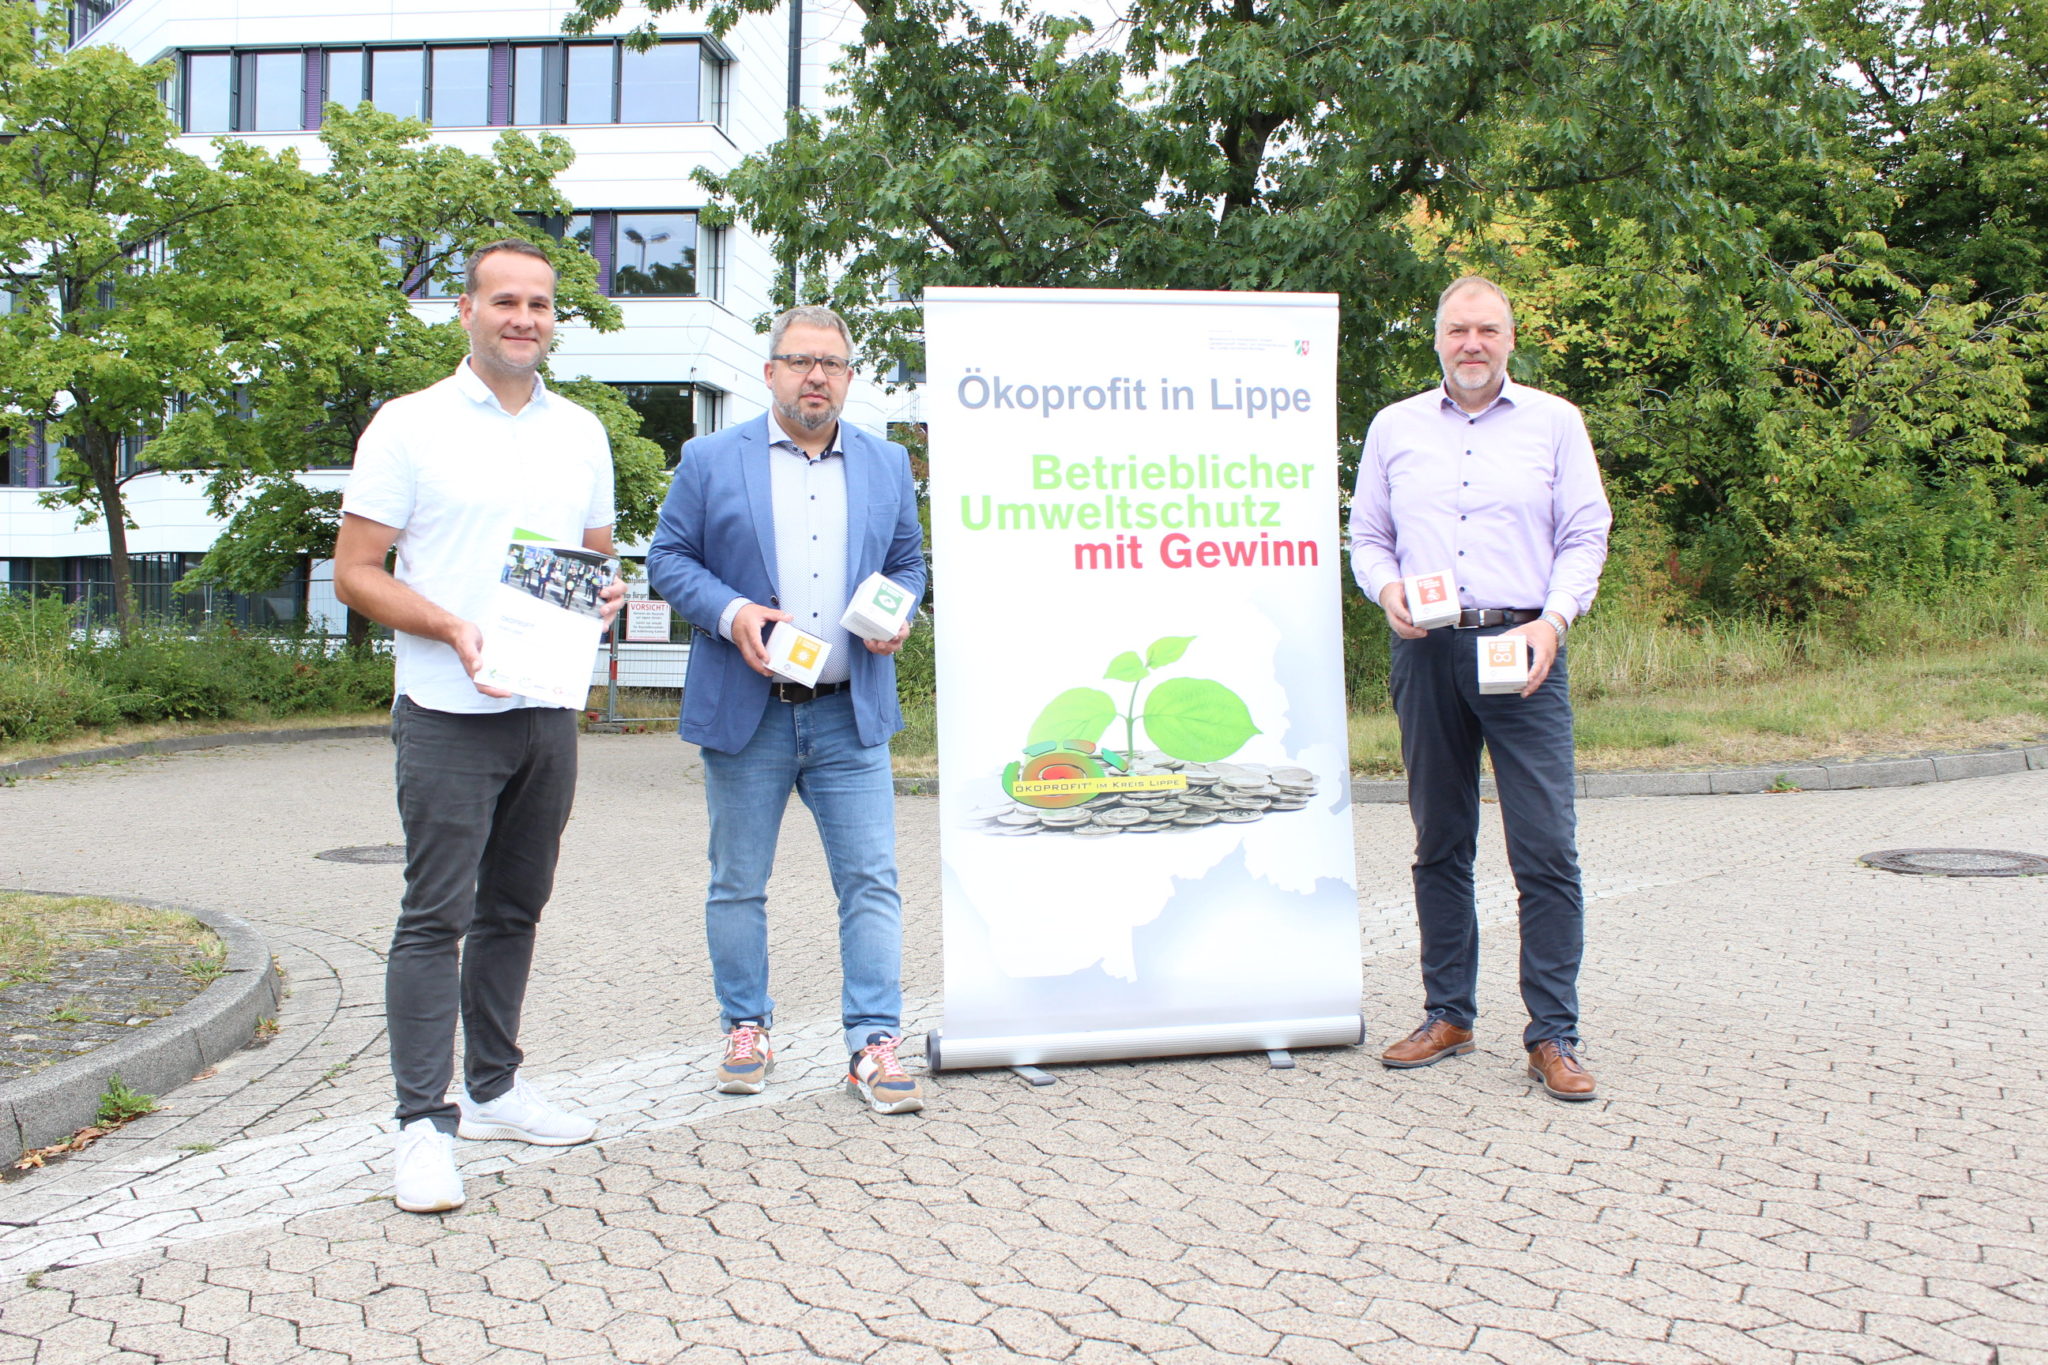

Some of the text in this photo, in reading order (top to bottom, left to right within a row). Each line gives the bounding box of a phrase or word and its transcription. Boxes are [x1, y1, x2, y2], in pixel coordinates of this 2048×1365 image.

[957, 367, 1312, 419] Ökoprofit in Lippe
[1032, 453, 1315, 491] Betrieblicher
[960, 494, 1281, 531] Umweltschutz
[1074, 531, 1319, 570] mit Gewinn
